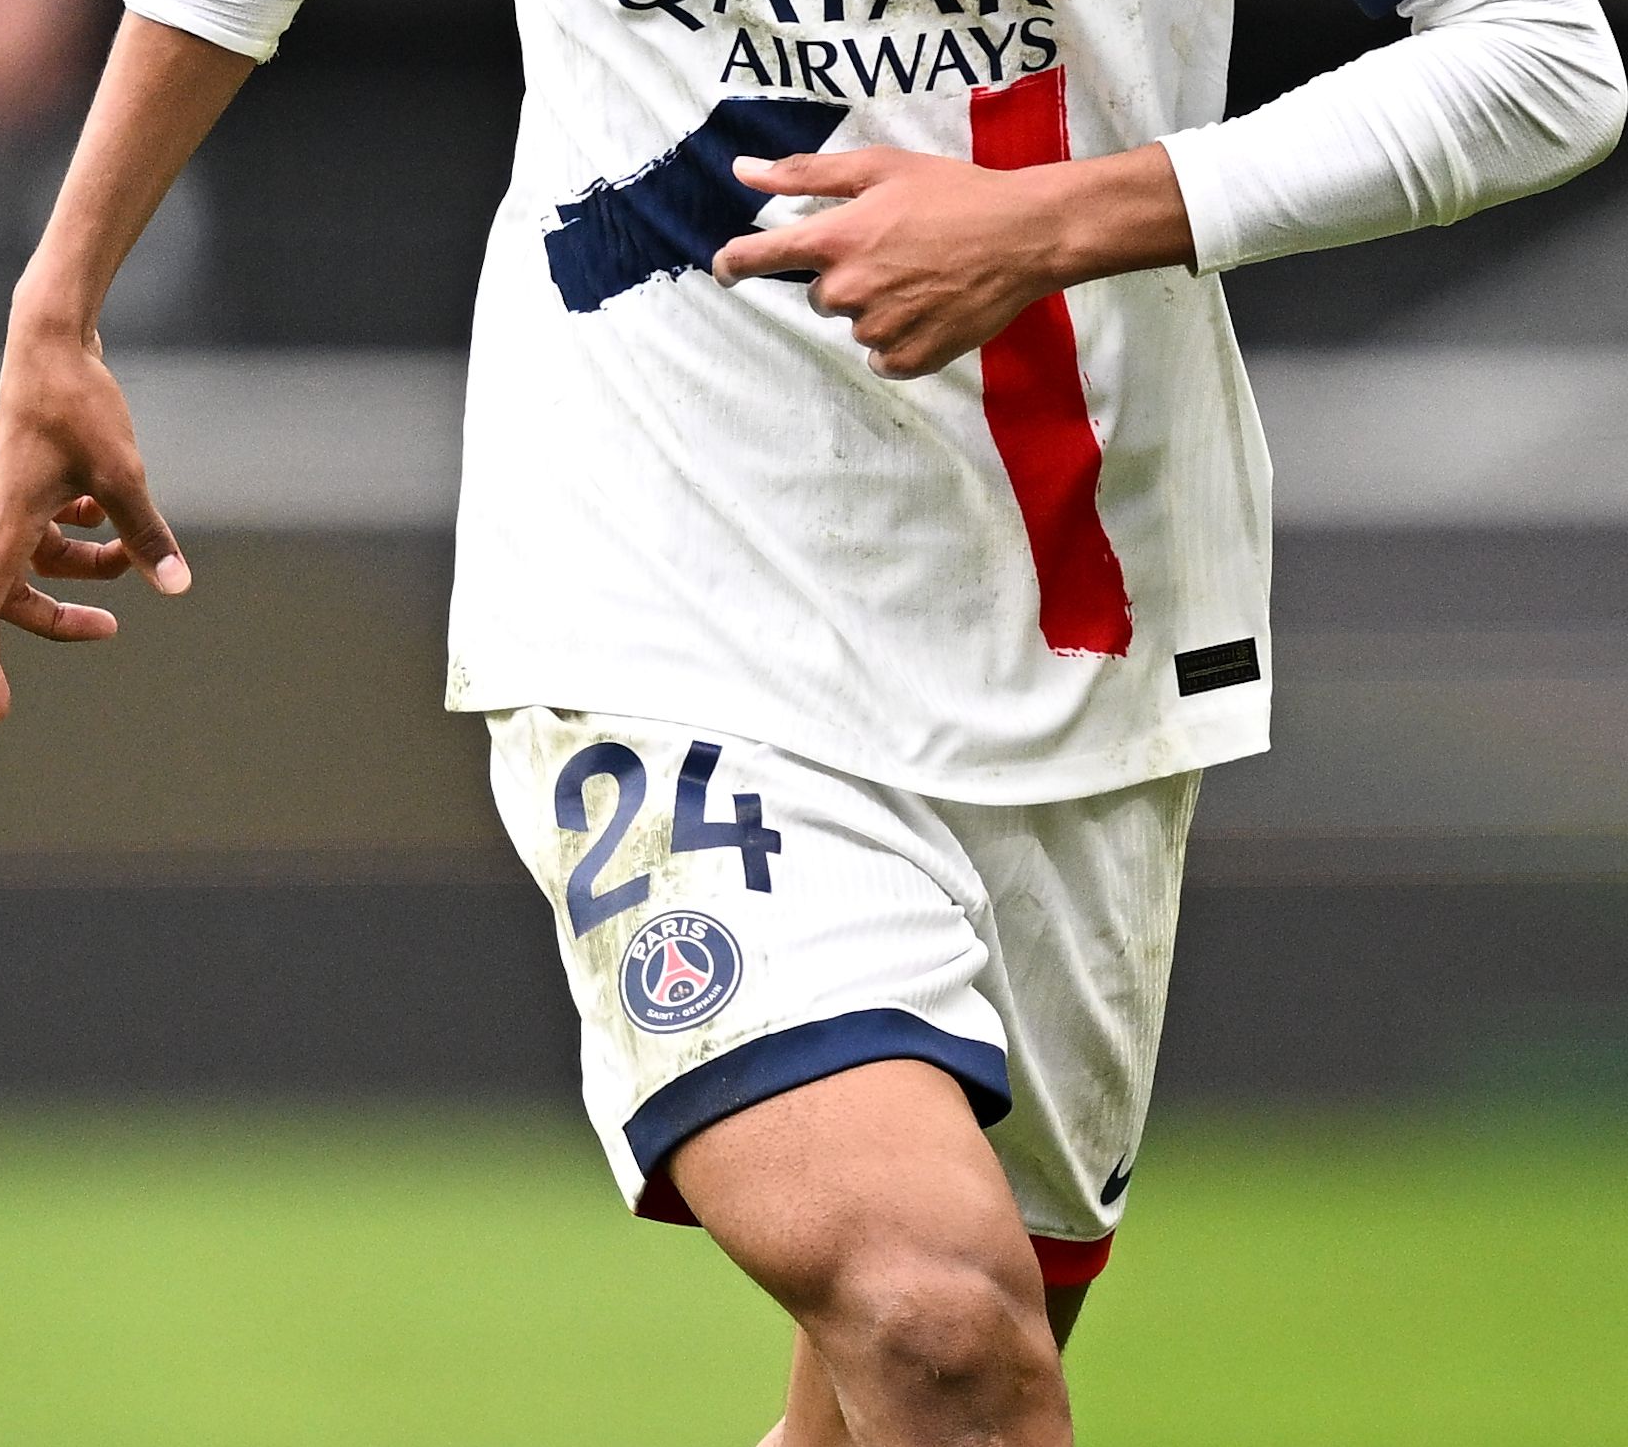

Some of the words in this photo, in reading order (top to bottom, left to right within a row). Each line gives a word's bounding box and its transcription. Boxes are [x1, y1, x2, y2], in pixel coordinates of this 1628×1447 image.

[719, 17, 1058, 98] AIRWAYS
[554, 739, 782, 941] 24
[631, 918, 709, 961] PARIS
[646, 1008, 675, 1021] SAINT
[682, 983, 724, 1018] GERMAIN
